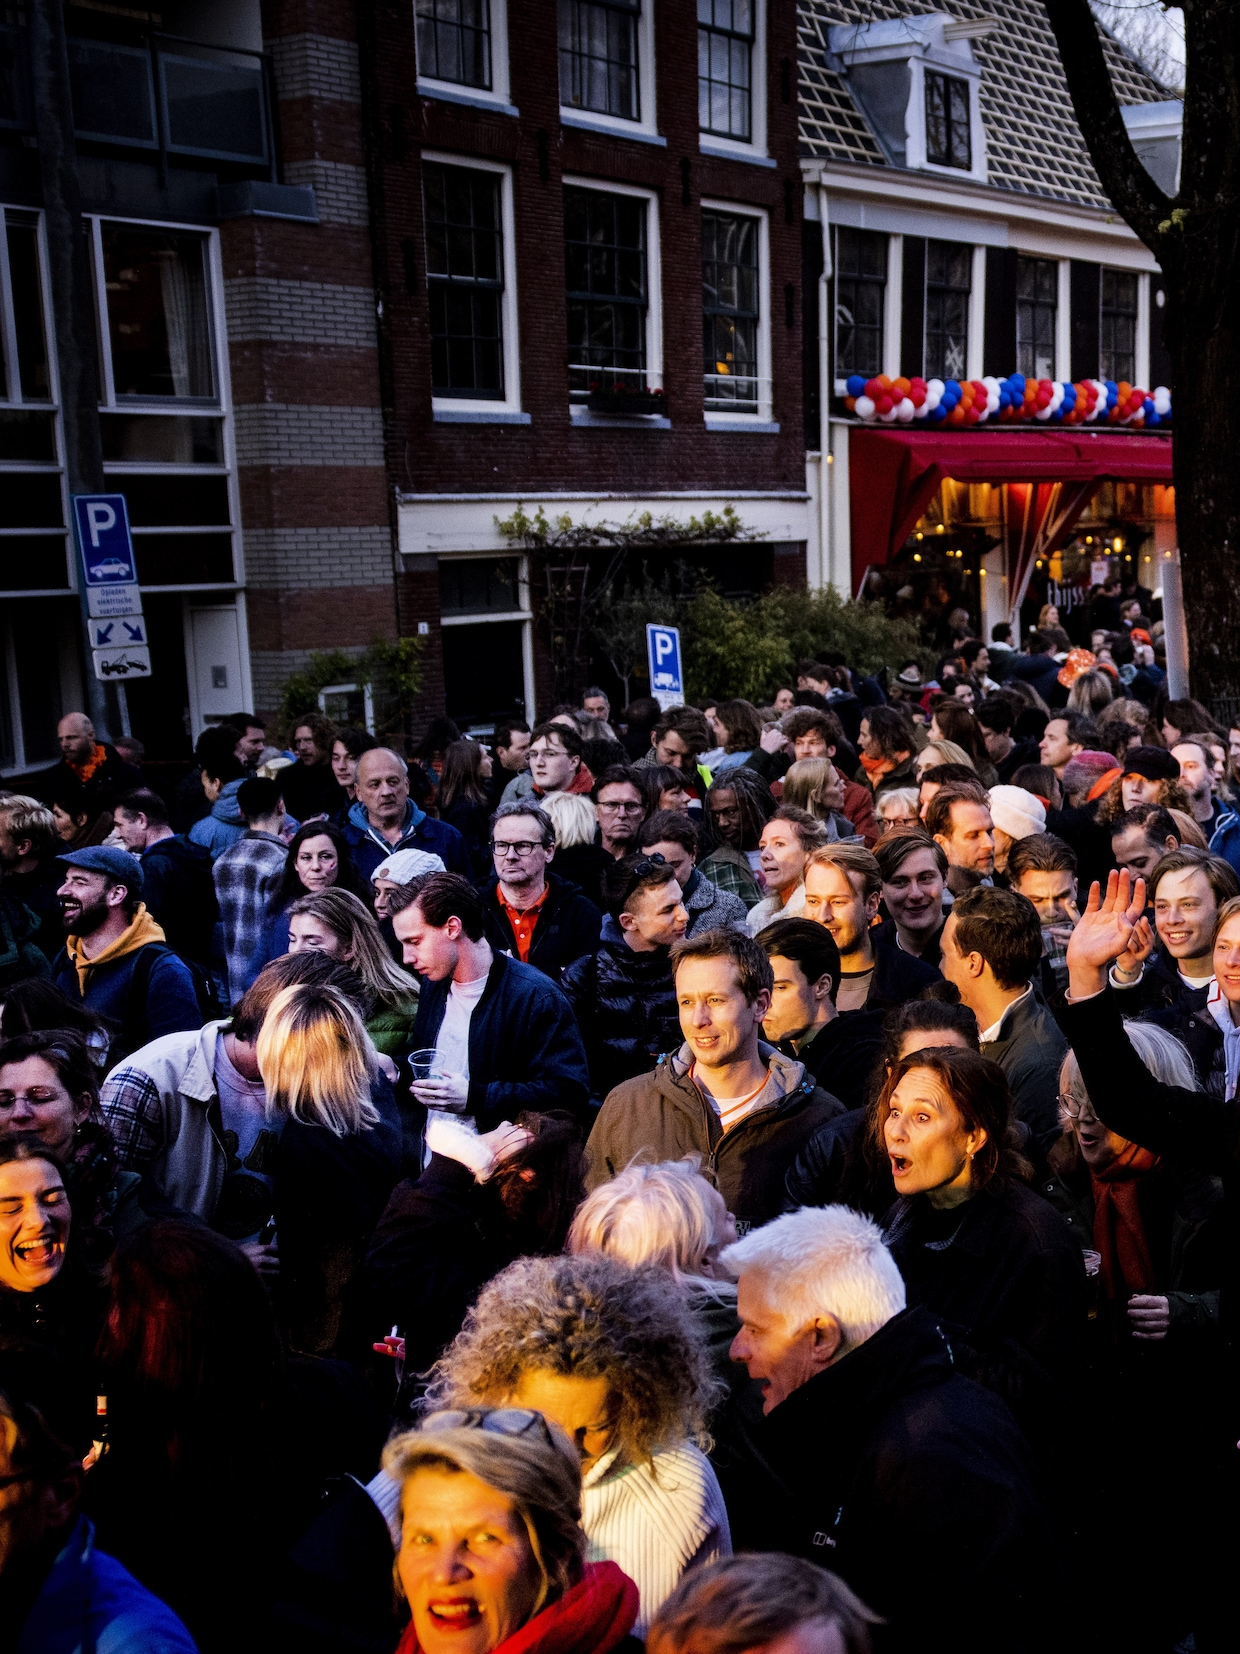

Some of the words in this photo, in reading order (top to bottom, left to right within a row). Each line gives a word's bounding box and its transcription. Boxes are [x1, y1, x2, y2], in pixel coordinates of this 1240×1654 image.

[86, 502, 116, 547] P
[97, 597, 133, 605] elektrische
[100, 588, 126, 596] Opladen
[655, 632, 673, 665] P
